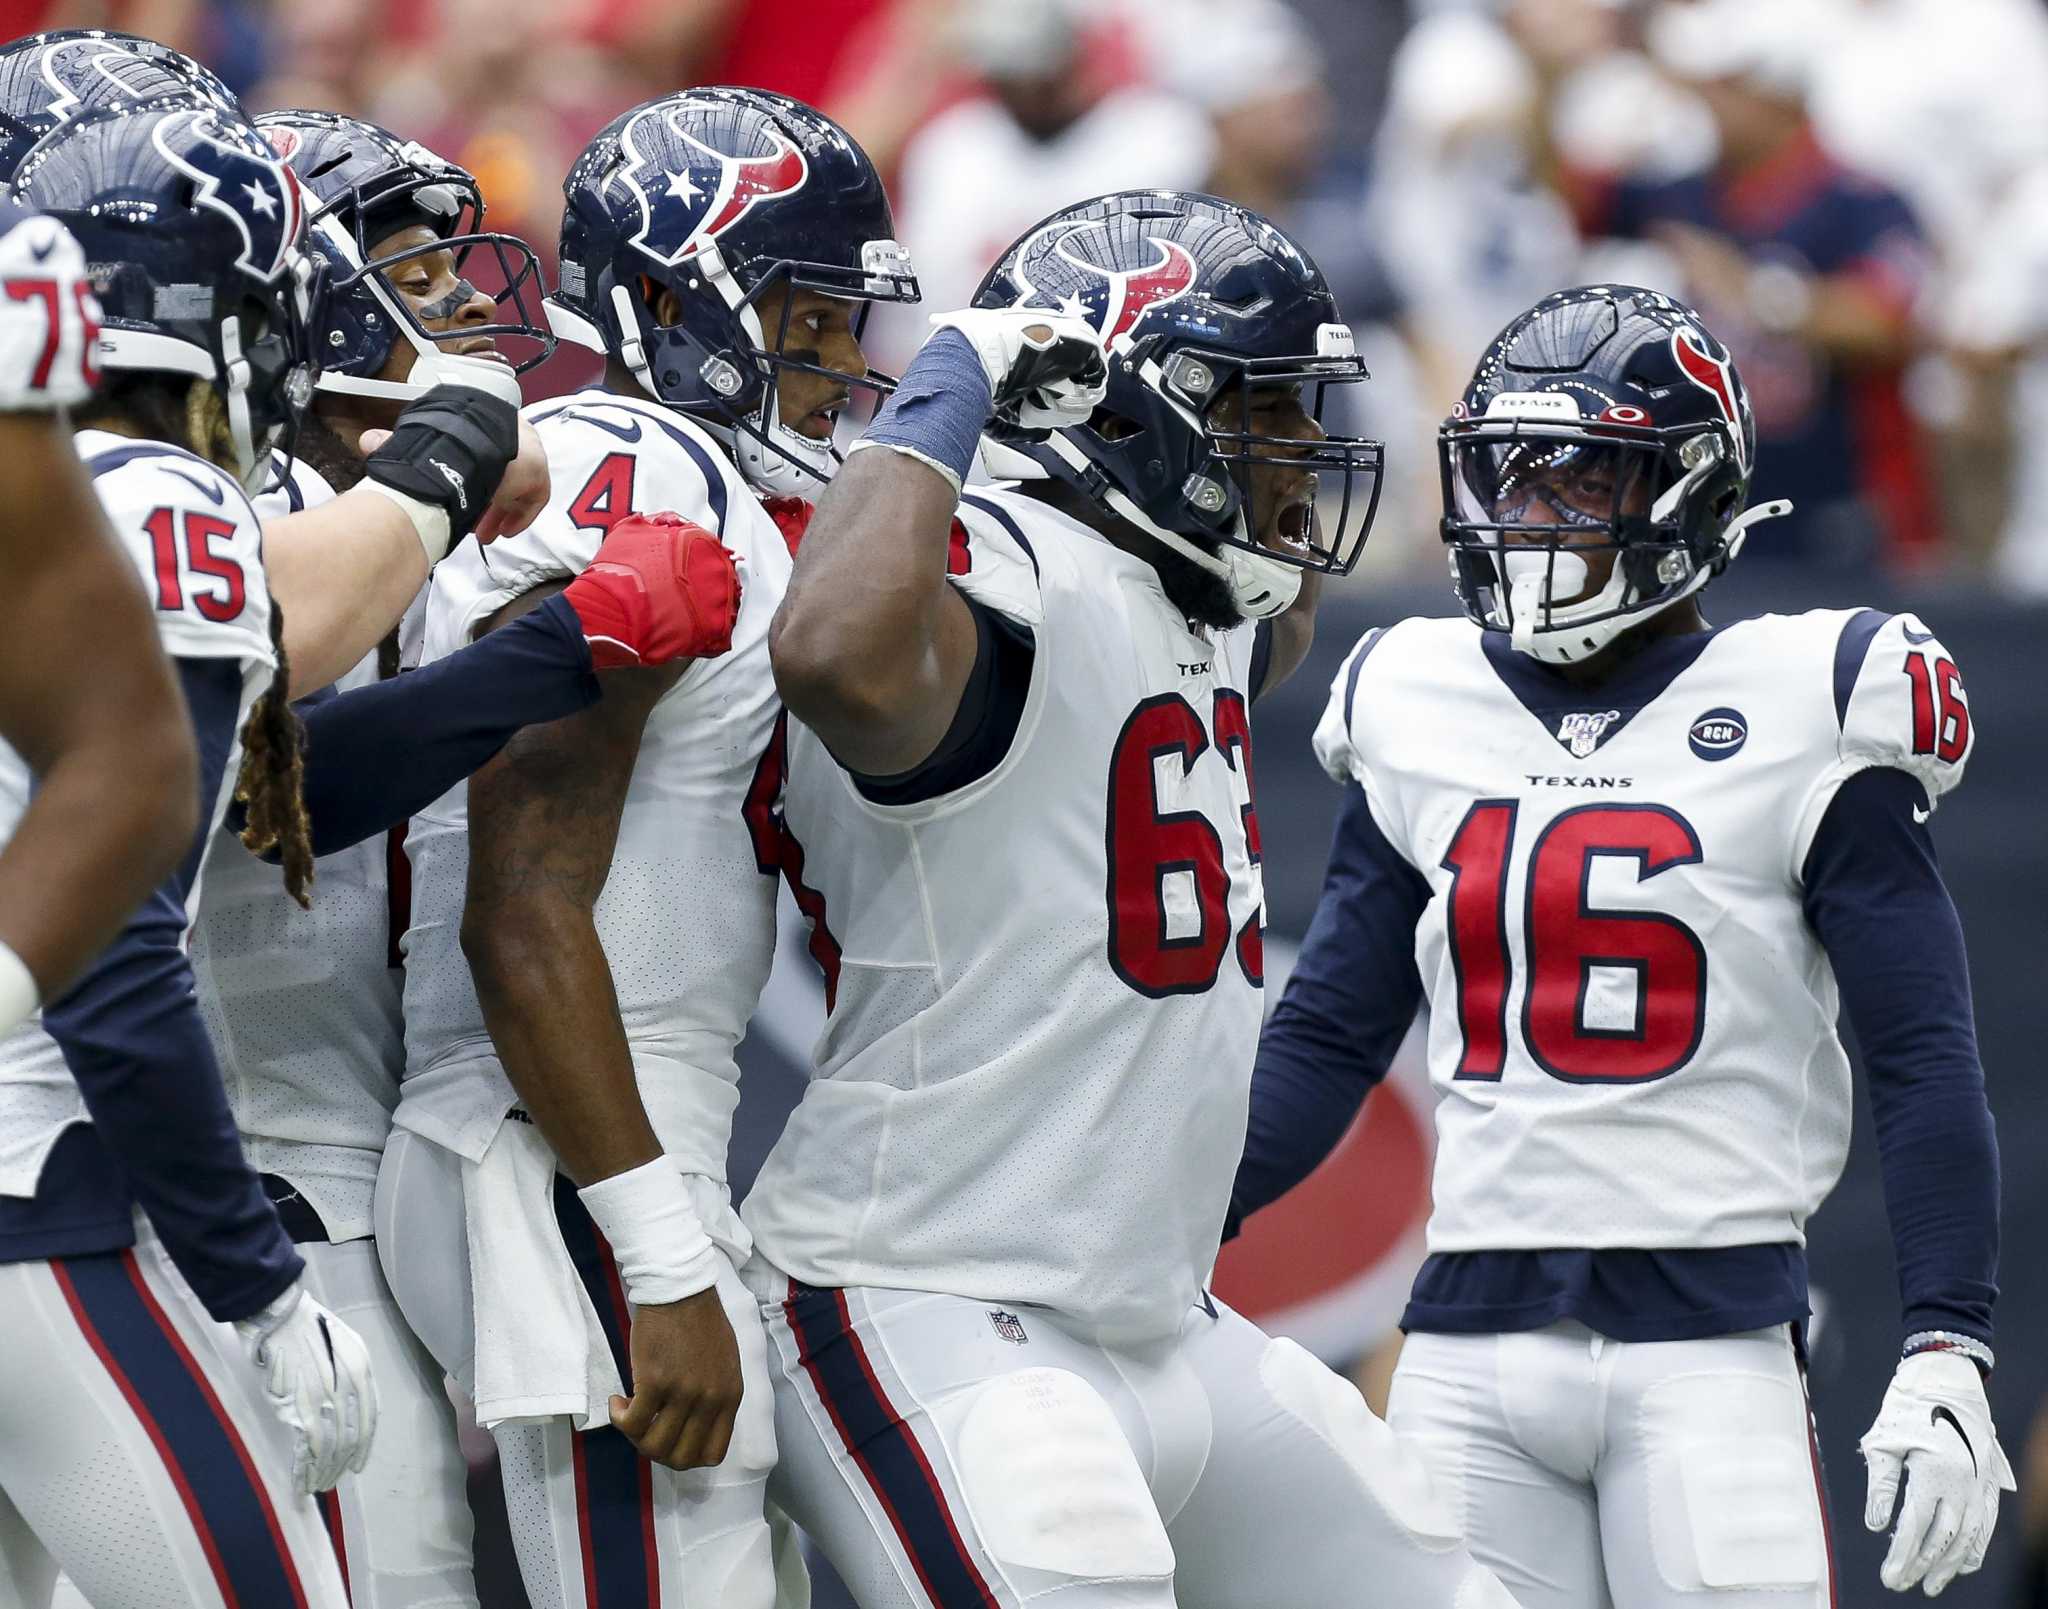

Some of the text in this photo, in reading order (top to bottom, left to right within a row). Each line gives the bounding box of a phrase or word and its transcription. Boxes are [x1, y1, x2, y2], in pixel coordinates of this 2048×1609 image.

[566, 451, 643, 546] 4
[142, 506, 246, 622] 15
[1175, 660, 1212, 676] TEX
[1903, 651, 1969, 764] 16
[1525, 775, 1634, 788] TEXANS
[1440, 798, 1708, 1085] 16
